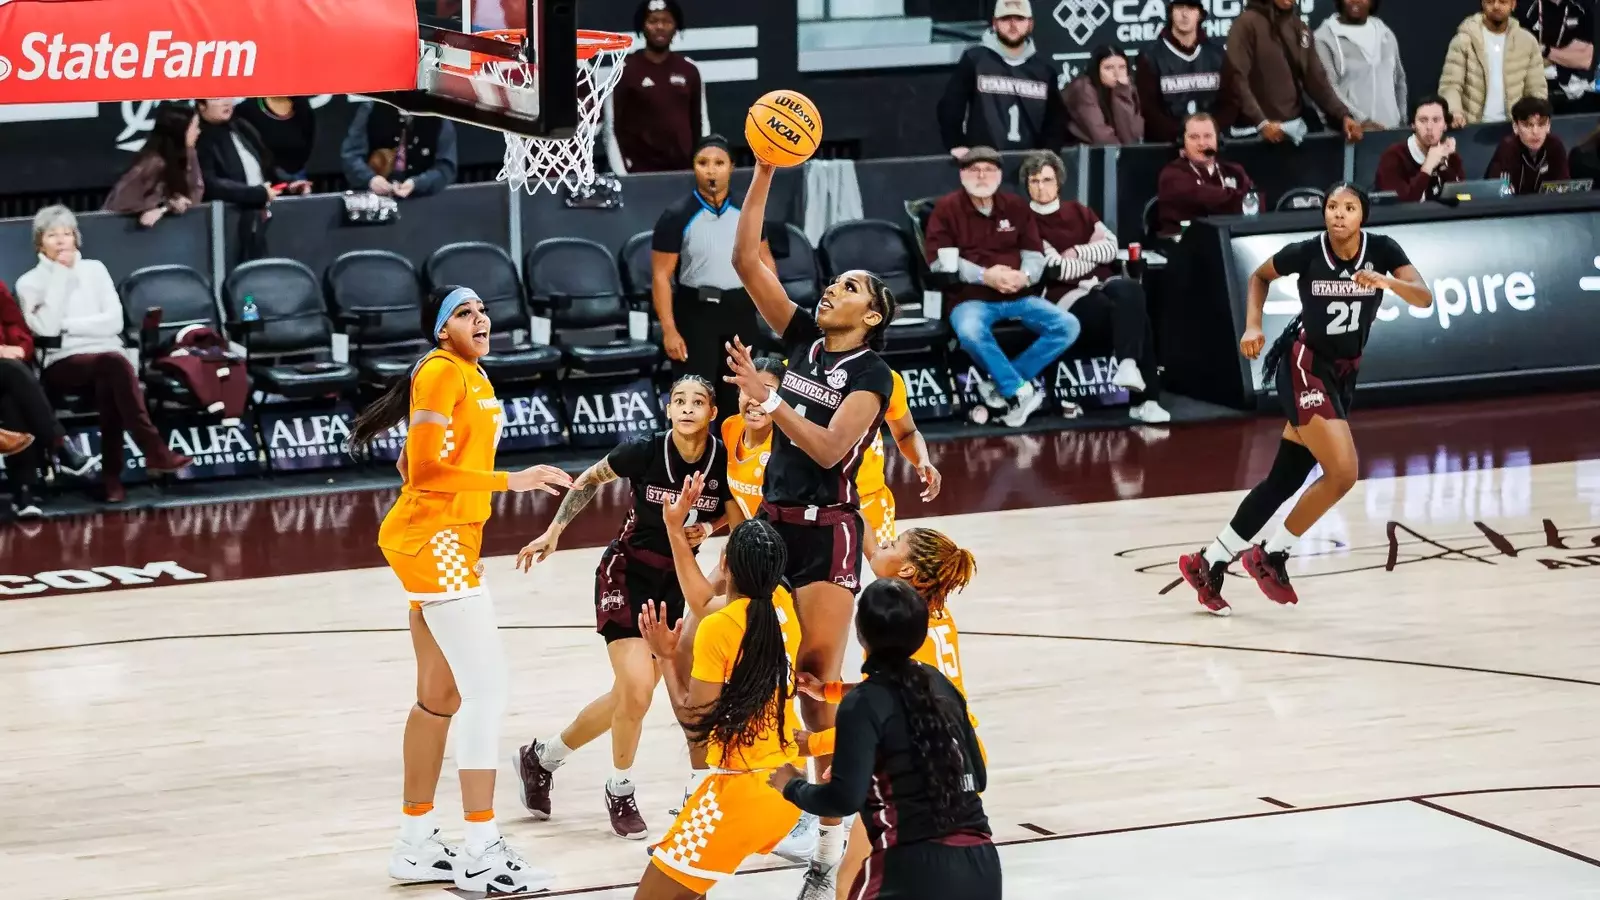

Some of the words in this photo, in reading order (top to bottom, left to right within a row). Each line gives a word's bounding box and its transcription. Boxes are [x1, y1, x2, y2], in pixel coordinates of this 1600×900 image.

[774, 95, 816, 132] Wilson
[1007, 104, 1021, 142] 1
[766, 116, 801, 146] NCAA
[1326, 301, 1362, 335] 21
[782, 374, 838, 406] STARKVEGAS
[901, 368, 943, 398] FA
[1053, 382, 1127, 398] INSURAN
[499, 396, 556, 428] LFA
[573, 391, 654, 423] ALFA
[168, 424, 252, 456] ALFA
[270, 414, 351, 448] ALFA
[501, 421, 560, 439] URANCE
[572, 418, 658, 435] INSURANCE
[192, 450, 257, 467] URANCE
[270, 441, 352, 460] INSURANC
[927, 624, 960, 679] 15
